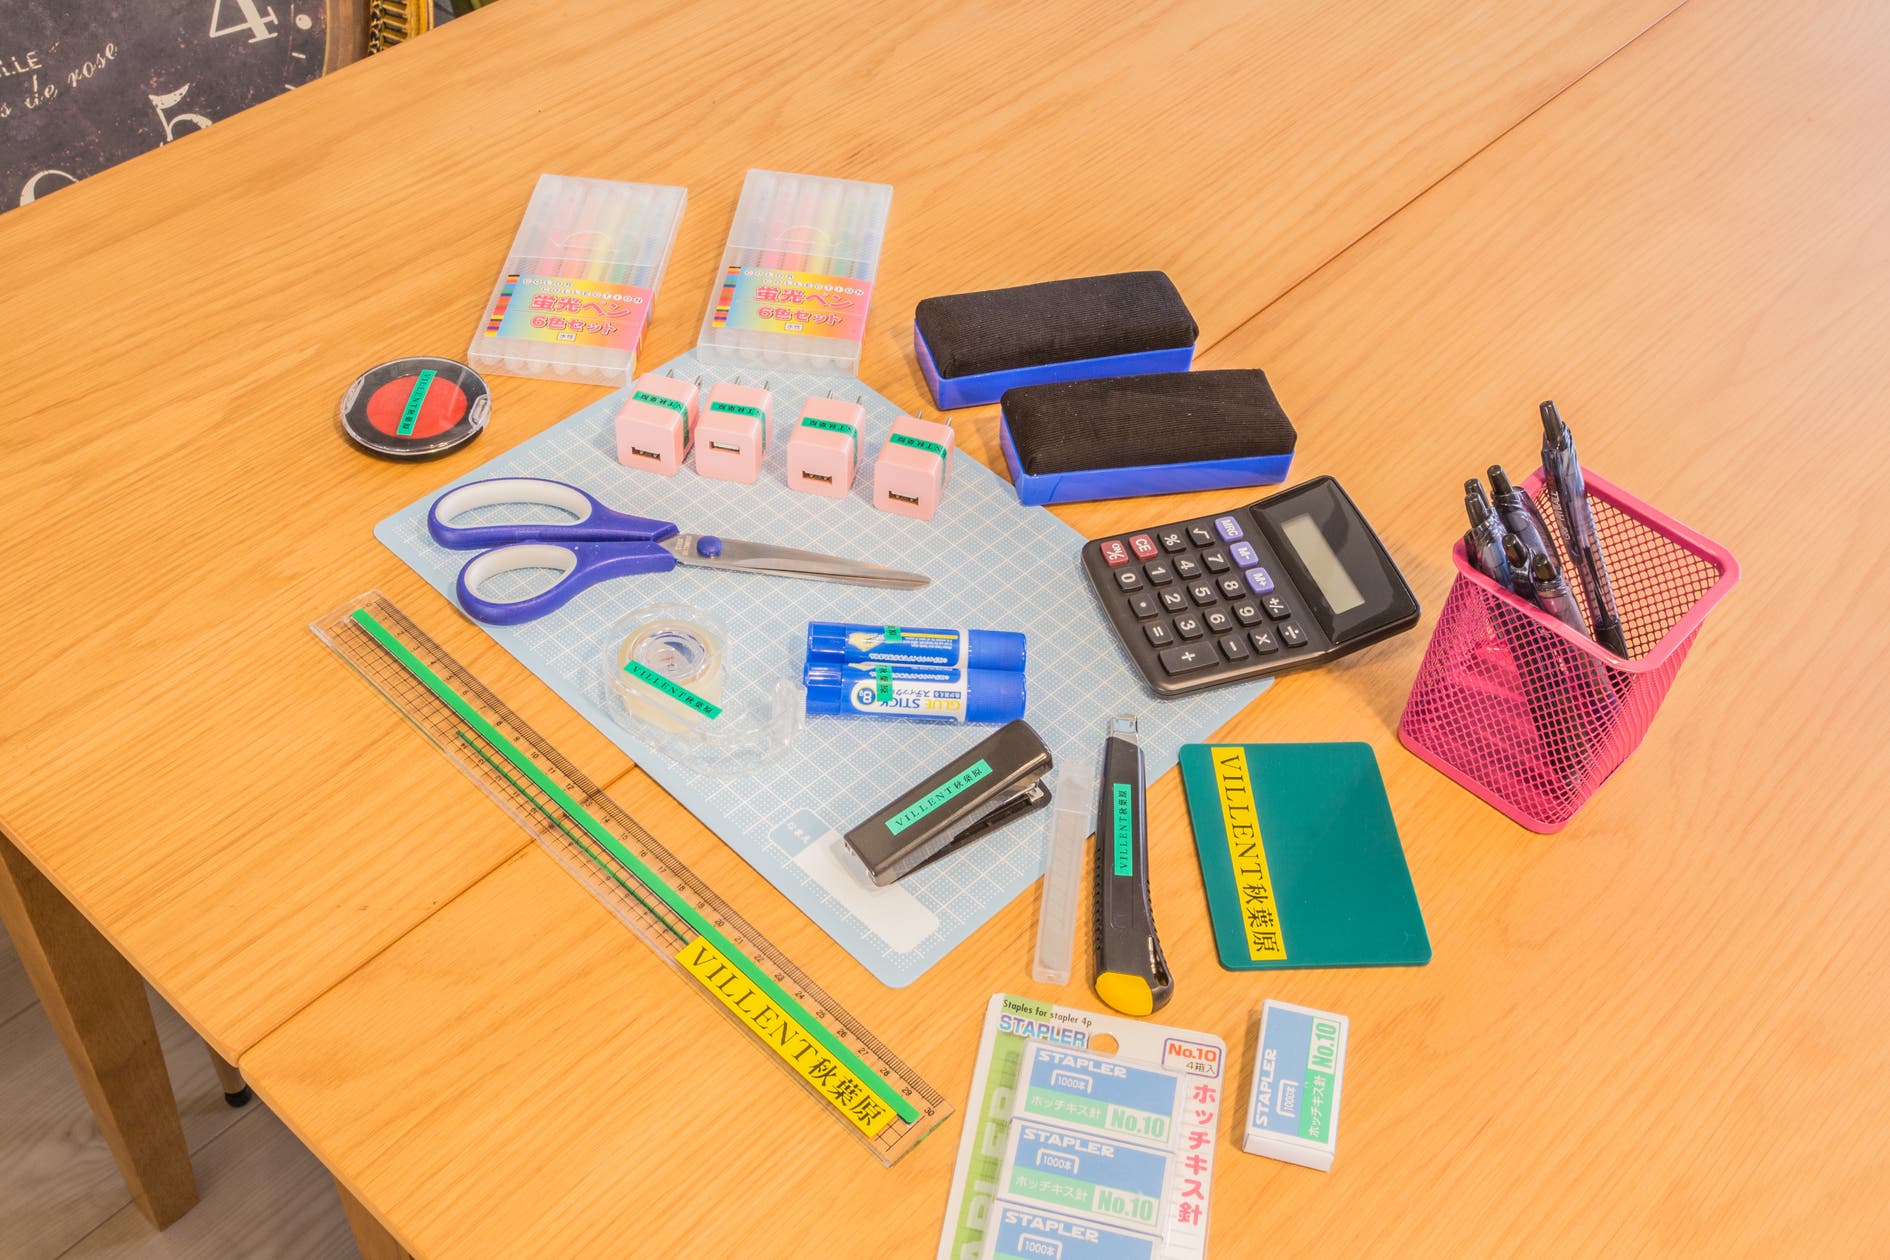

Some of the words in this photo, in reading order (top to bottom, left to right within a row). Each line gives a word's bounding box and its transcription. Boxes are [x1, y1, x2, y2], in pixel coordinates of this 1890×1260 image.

[67, 43, 118, 88] rose
[530, 293, 631, 317] 蛍光ペン
[755, 286, 854, 309] 蛍光ペン
[530, 315, 618, 335] 6色セット
[757, 306, 843, 326] 6色セット
[1220, 519, 1238, 537] MRC
[1136, 538, 1151, 552] CE
[1181, 560, 1194, 570] 4
[1208, 553, 1224, 564] 7
[1121, 573, 1136, 583] 0
[1152, 567, 1166, 575] 1
[1195, 587, 1211, 597] 5
[1224, 580, 1239, 590] 8
[1165, 593, 1181, 604] 2
[1210, 613, 1225, 624] 6
[1240, 606, 1254, 617] 9
[1180, 620, 1196, 630] 3
[880, 698, 920, 709] STICK
[926, 699, 962, 711] GLUE
[895, 767, 983, 826] VILLENT秋葉原
[1220, 754, 1280, 952] VILLENT秋葉原
[530, 751, 539, 759] 10
[566, 783, 575, 791] 12
[601, 815, 610, 824] 14
[621, 833, 628, 841] 15
[677, 884, 685, 892] 18
[697, 901, 705, 909] 19
[715, 919, 725, 927] 20
[734, 936, 744, 944] 21
[754, 954, 765, 962] 22
[774, 972, 785, 982] 23
[795, 991, 805, 999] 24
[816, 1010, 825, 1019] 25
[837, 1028, 847, 1038] 26
[858, 1047, 869, 1056] 27
[880, 1067, 890, 1077] 28
[902, 1087, 913, 1097] 29
[924, 1107, 935, 1117] 30
[1002, 999, 1033, 1016] Staples
[1035, 1006, 1047, 1017] for
[1050, 1012, 1078, 1026] stapler
[1081, 1017, 1092, 1027] 4p
[690, 946, 887, 1127] VILLENT秋葉原
[999, 1014, 1088, 1048] STAPLER
[1168, 1043, 1217, 1062] No.10
[1311, 1022, 1337, 1069] No.10
[1038, 1051, 1127, 1078] STAPLER
[1186, 1062, 1216, 1074] 4箱入
[1057, 1074, 1088, 1089] 1000本
[1255, 1048, 1278, 1126] STAPLER
[1309, 1075, 1327, 1137] ホッチキス針
[1031, 1094, 1100, 1120] ホッチキス針
[1110, 1110, 1165, 1139] No.10
[1023, 1128, 1115, 1158] STAPLER
[1043, 1154, 1074, 1171] 1000本
[1178, 1083, 1217, 1225] ホッチキス針
[1016, 1175, 1088, 1201] ホッチキス針
[1098, 1189, 1153, 1219] No.10
[1005, 1211, 1100, 1244] STAPLER
[1025, 1240, 1056, 1256] 1000本
